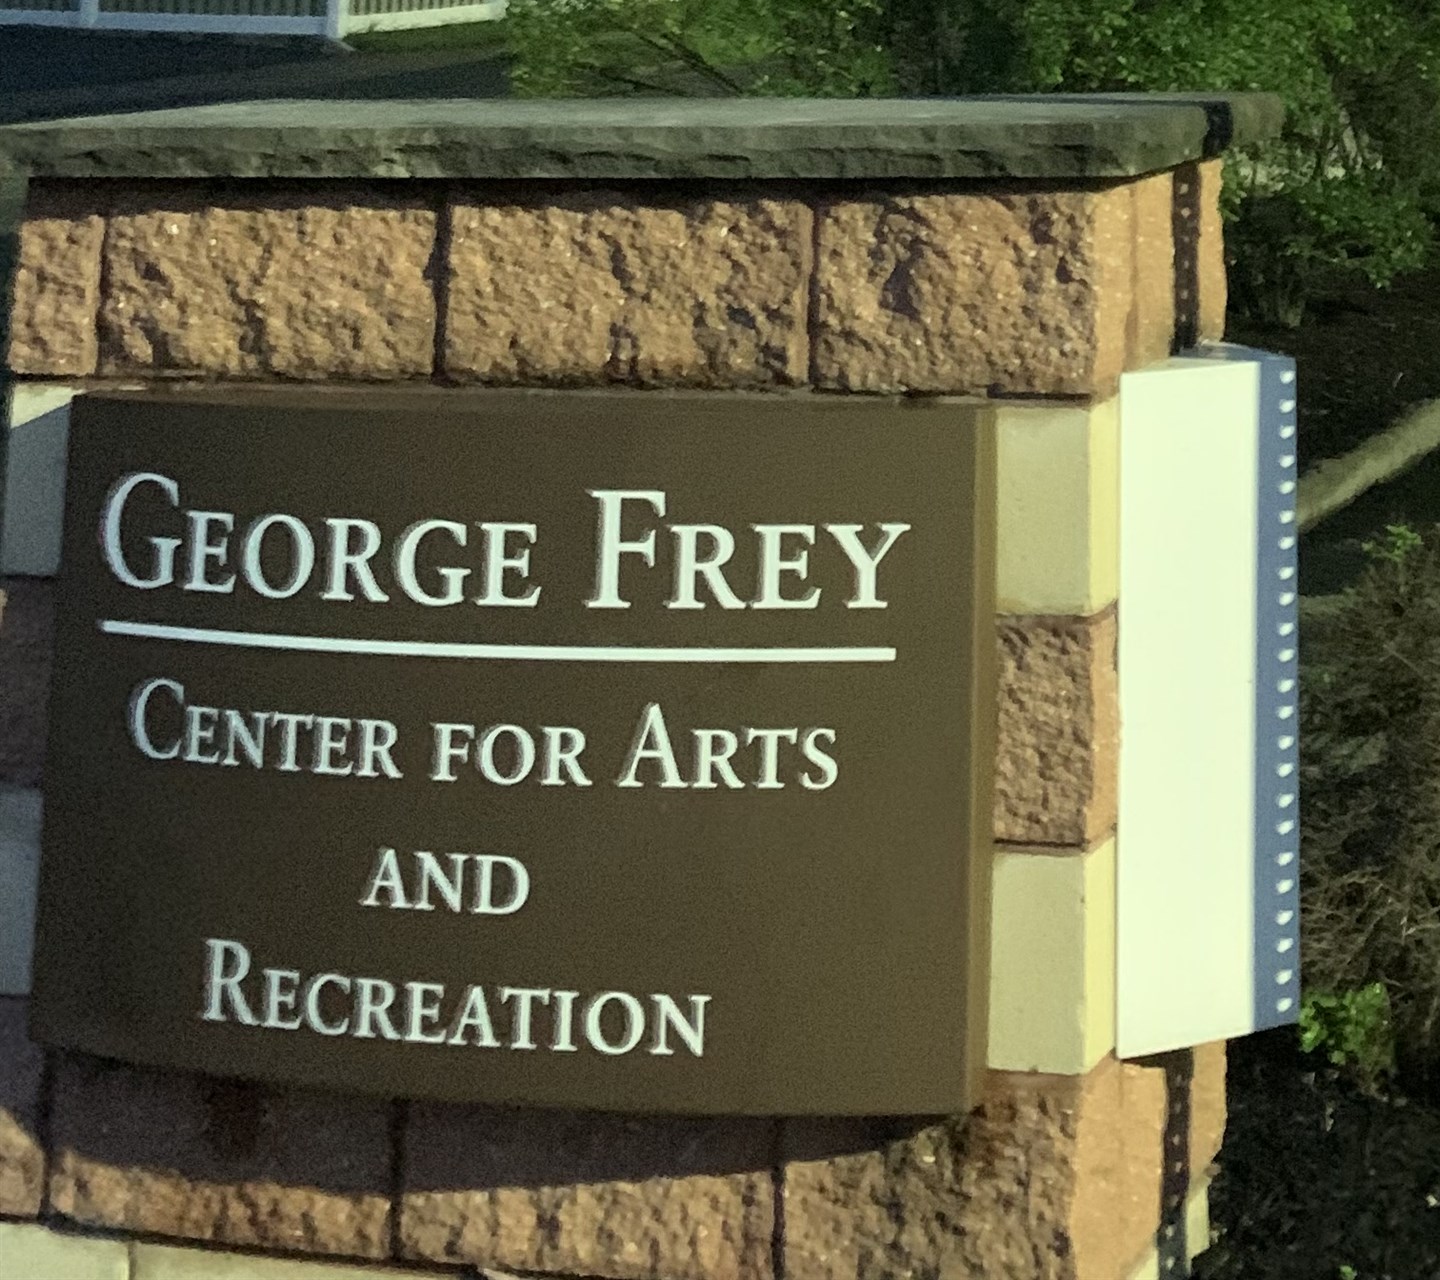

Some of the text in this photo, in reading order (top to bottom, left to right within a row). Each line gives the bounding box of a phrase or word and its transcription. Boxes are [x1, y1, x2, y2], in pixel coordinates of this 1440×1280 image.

[101, 471, 912, 611] GEORGE FREY
[128, 677, 840, 791] CENTER FOR ARTS
[358, 847, 532, 916] AND
[201, 938, 713, 1058] RECREATION
